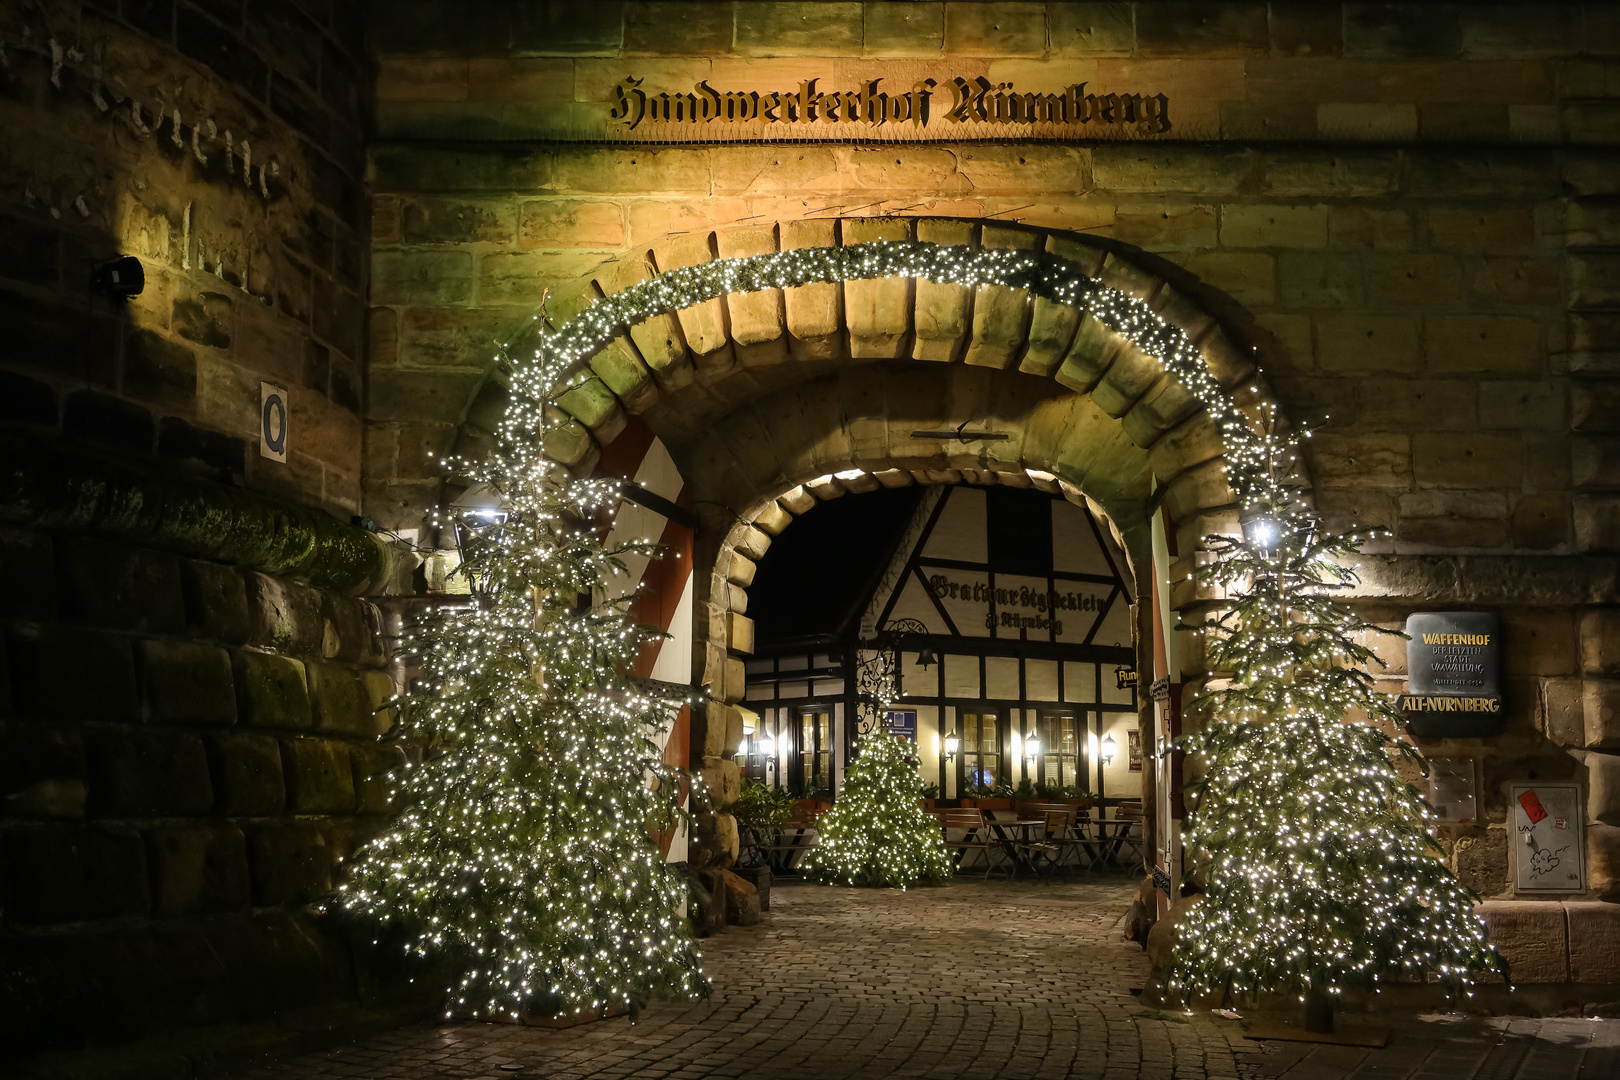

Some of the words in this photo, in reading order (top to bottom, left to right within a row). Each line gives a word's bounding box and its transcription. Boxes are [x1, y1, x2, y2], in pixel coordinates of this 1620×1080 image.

[610, 75, 938, 130] Handwerkerhof
[942, 75, 1172, 133] Nürnberg
[1422, 632, 1491, 646] WAFFENHOF
